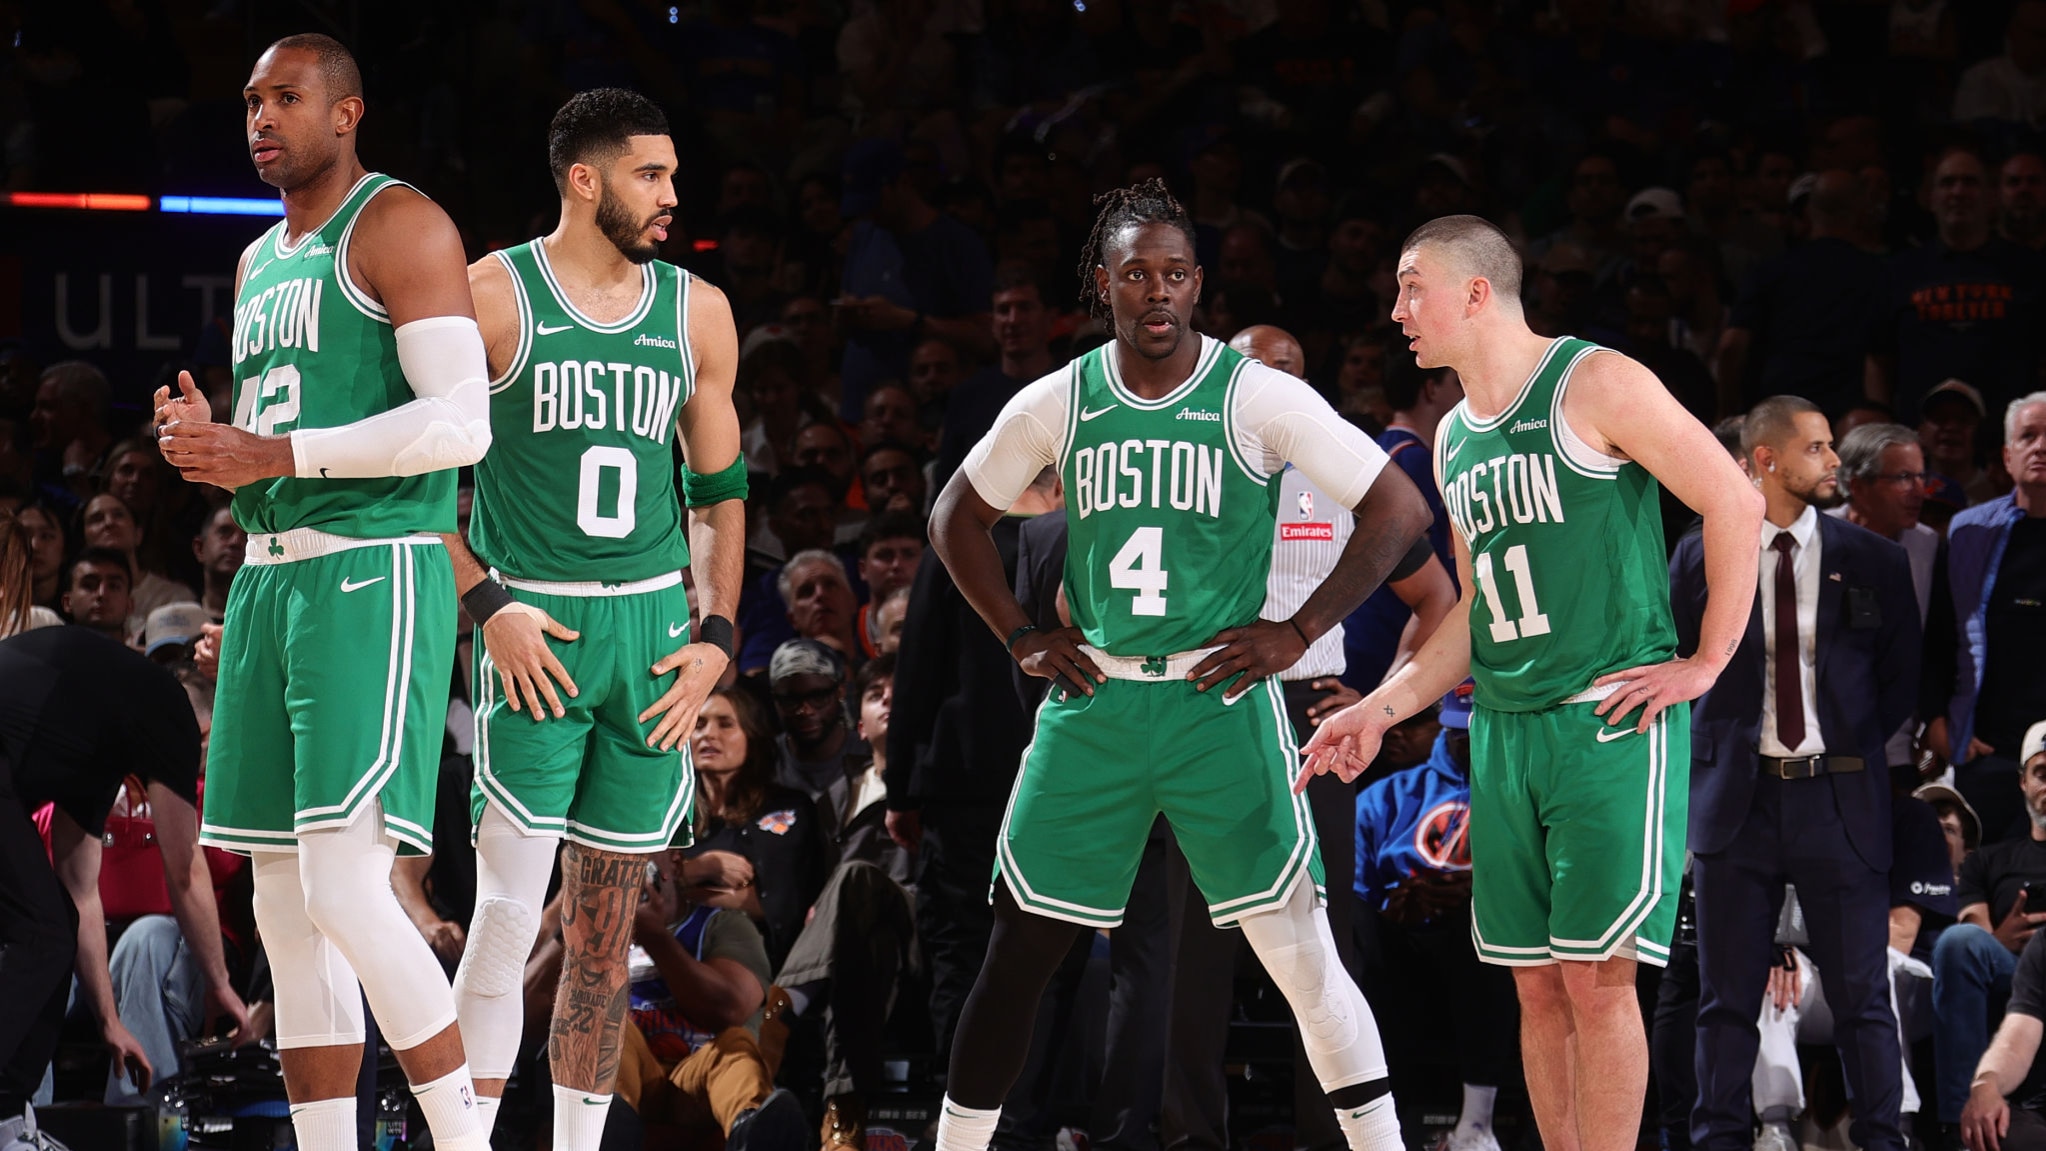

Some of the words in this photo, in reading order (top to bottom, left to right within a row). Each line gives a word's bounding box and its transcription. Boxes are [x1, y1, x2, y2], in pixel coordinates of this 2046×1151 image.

[304, 243, 334, 258] Amica
[634, 334, 676, 349] Amica
[231, 363, 301, 437] 42
[533, 360, 681, 445] BOSTON
[1176, 407, 1221, 422] Amica
[1510, 418, 1547, 434] Amica
[577, 445, 637, 539] 0
[1076, 439, 1223, 520] BOSTON
[1282, 525, 1332, 538] Emirates
[1109, 526, 1168, 617] 4
[1476, 544, 1551, 643] 11
[569, 1003, 595, 1034] 22
